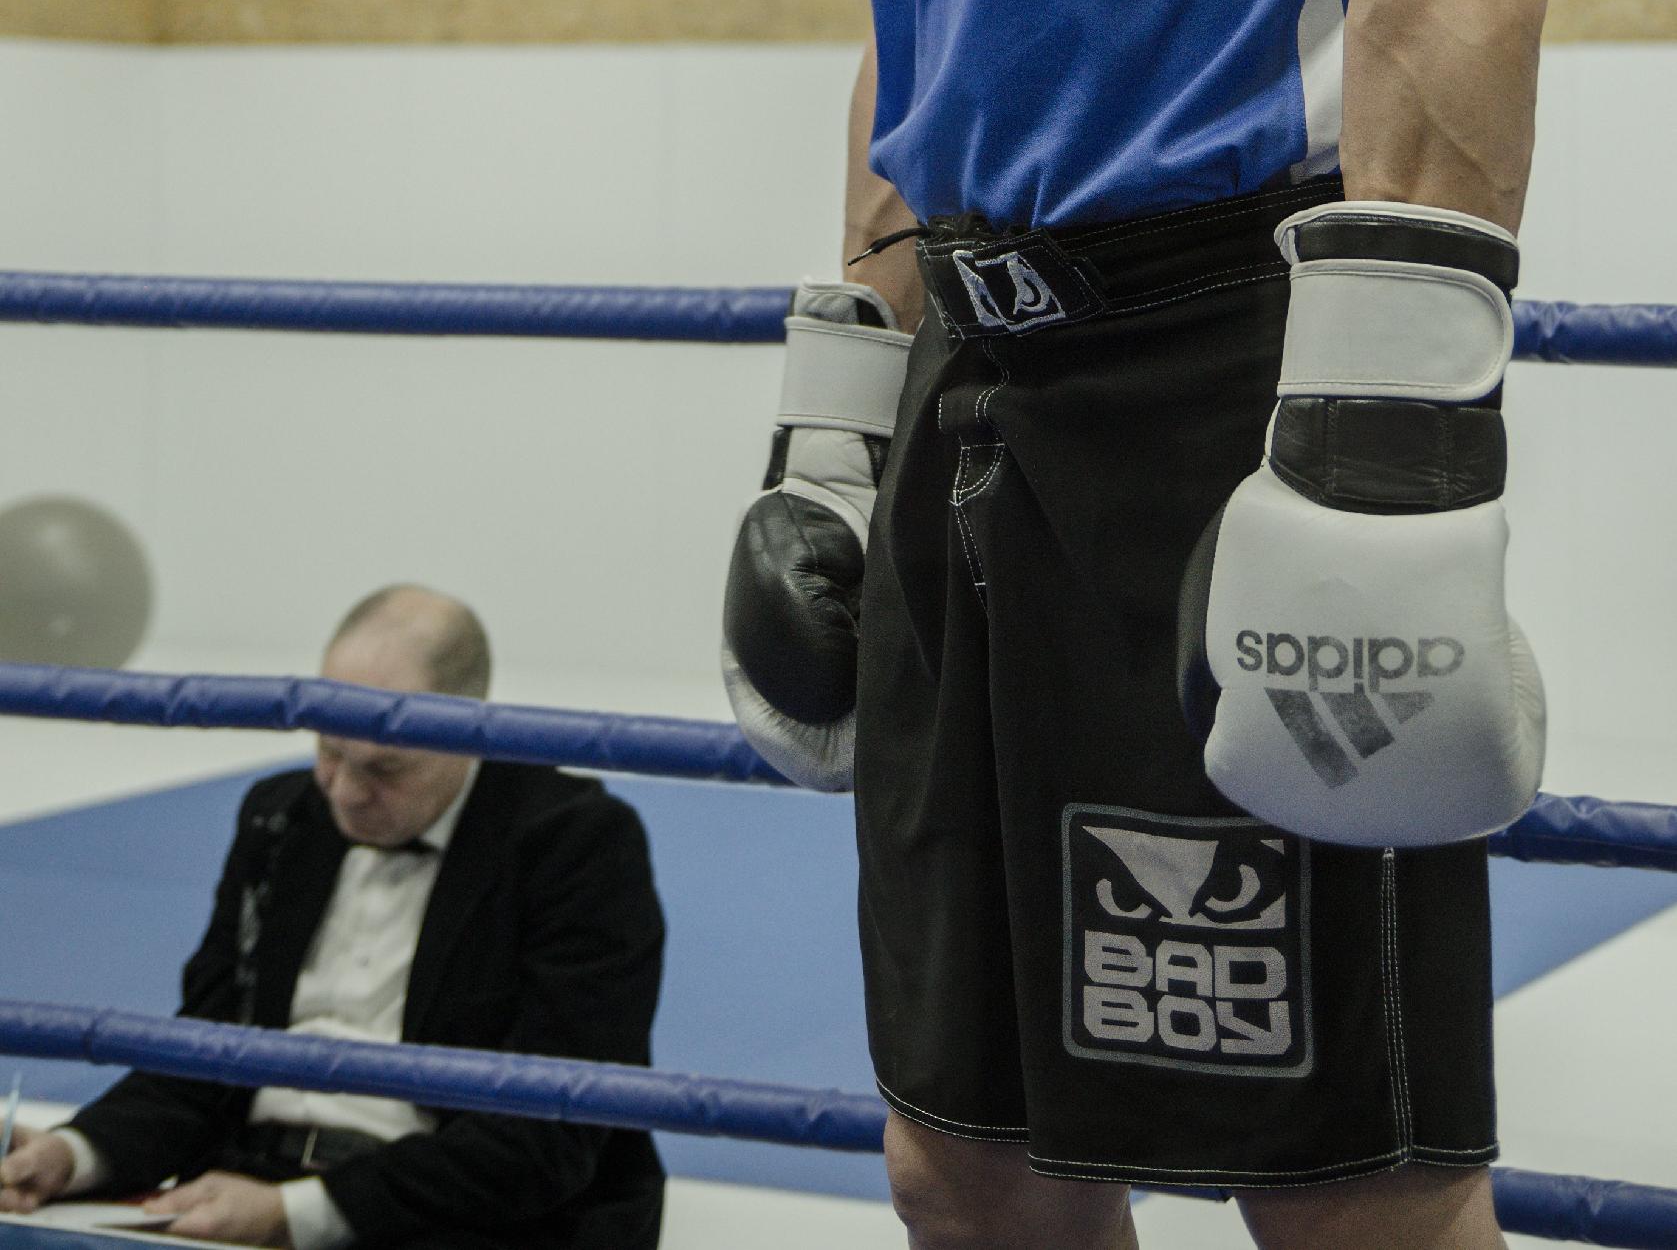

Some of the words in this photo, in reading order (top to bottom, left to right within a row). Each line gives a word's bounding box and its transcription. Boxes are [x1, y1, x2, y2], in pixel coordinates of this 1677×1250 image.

[1236, 630, 1465, 695] adidas
[1083, 929, 1287, 999] BAD
[1083, 985, 1292, 1055] BOY
